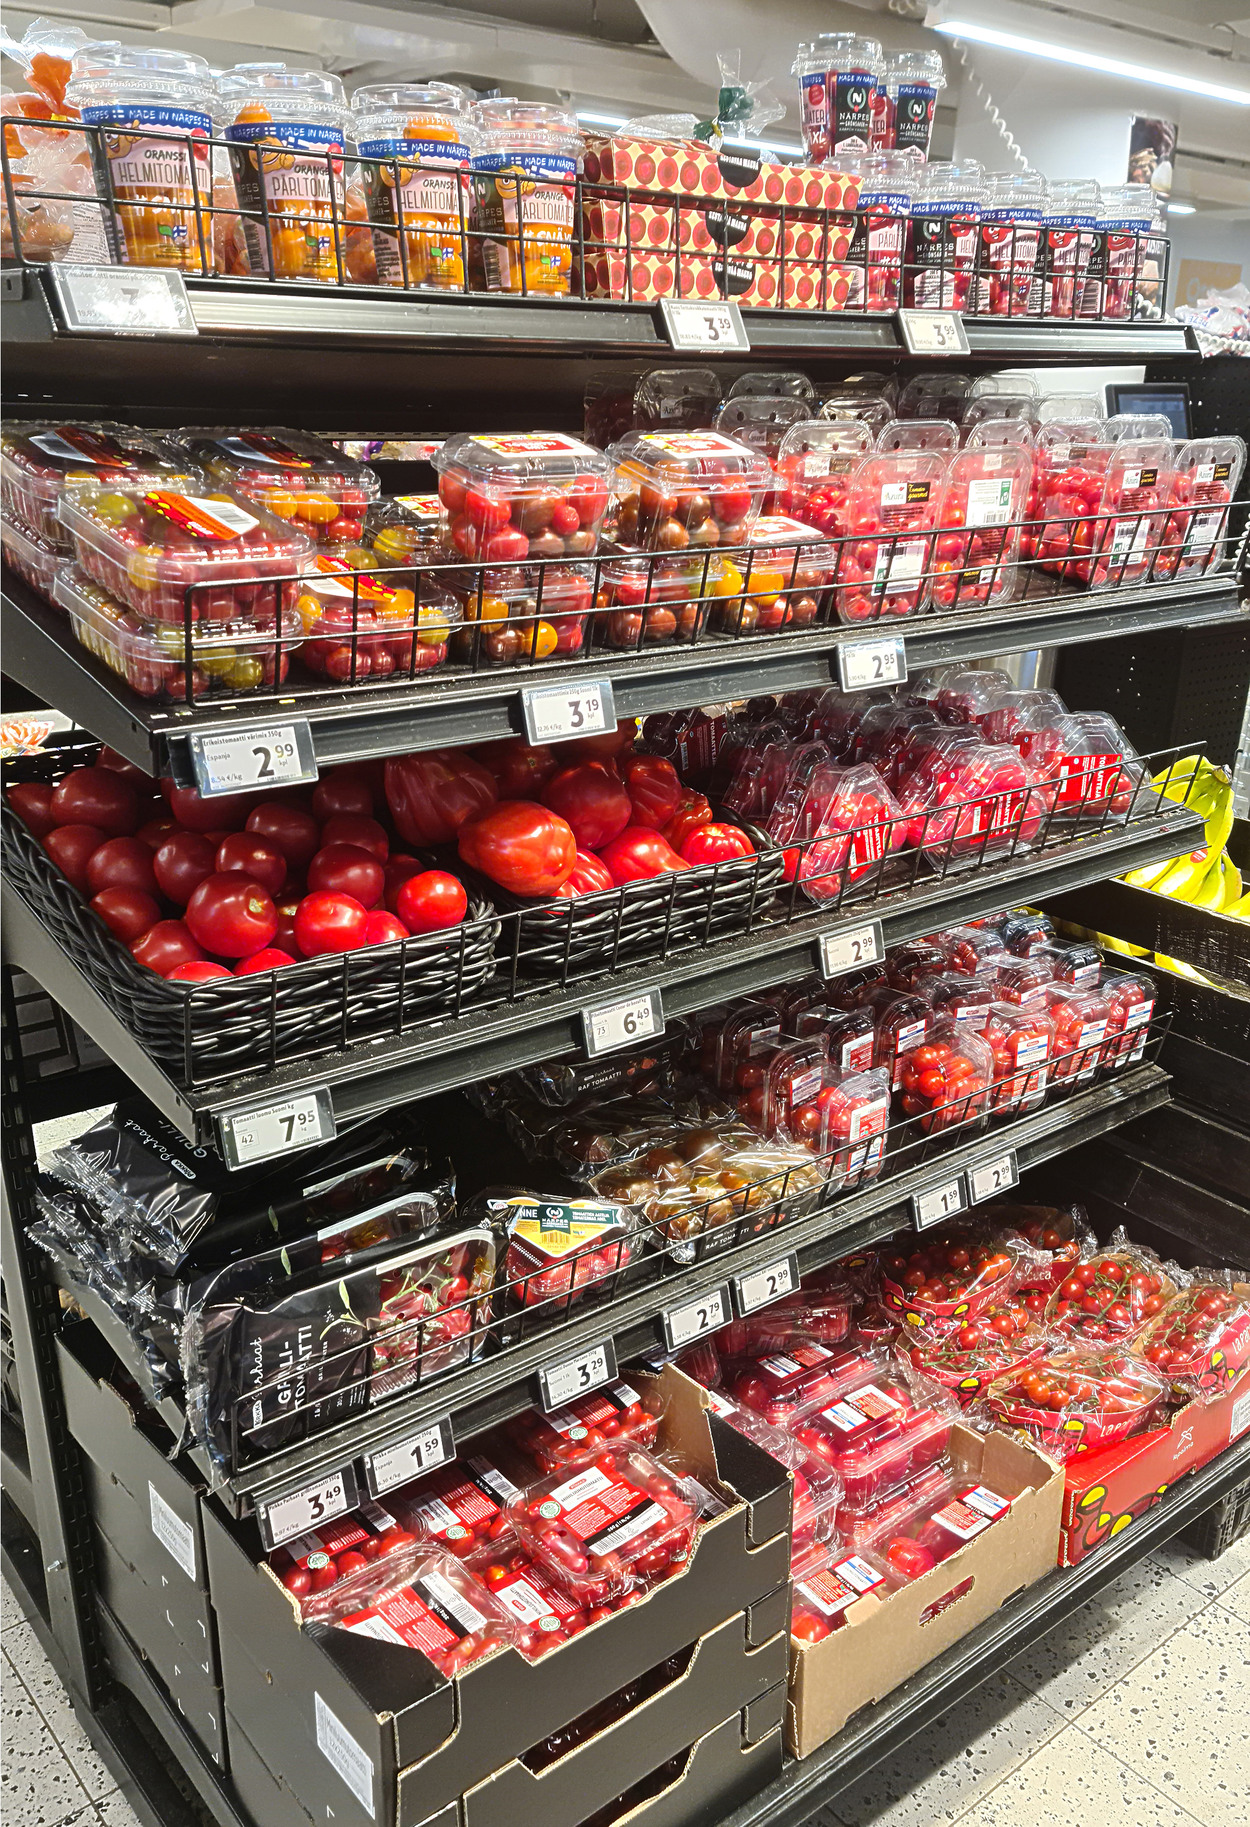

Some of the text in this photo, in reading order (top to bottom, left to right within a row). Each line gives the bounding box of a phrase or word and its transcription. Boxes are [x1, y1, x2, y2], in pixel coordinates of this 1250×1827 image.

[144, 149, 187, 162] ORANSSI
[117, 161, 208, 189] HELMITOMATTI
[271, 174, 344, 200] PÄRLTOMAER
[534, 190, 565, 202] ORANGE
[703, 316, 731, 341] 3 39
[932, 324, 955, 346] 3 99
[871, 653, 895, 679] 2 95
[567, 698, 599, 728] 3 19
[202, 734, 247, 747] Erikoistomaatti
[267, 729, 283, 738] 350g
[206, 742, 295, 779] Espanja 2 99
[850, 940, 863, 963] 2
[862, 936, 873, 948] 99
[596, 1007, 650, 1036] 73 6 49
[577, 1070, 622, 1092] RAF TOMAATTI
[232, 1102, 295, 1126] Tomaatti luomu Suomi kg
[241, 1109, 316, 1145] 42 7 95
[123, 1118, 175, 1161] Parhaat
[992, 1165, 1010, 1189] 2 99
[519, 1208, 538, 1219] NNE
[940, 1193, 949, 1212] 1
[948, 1189, 958, 1201] 59
[705, 1226, 750, 1250] RAF TOMATTI
[766, 1269, 789, 1297] 2 99
[696, 1308, 709, 1331] 2
[708, 1302, 720, 1315] 79
[577, 1356, 604, 1388] 3 29
[410, 1444, 424, 1469] 1
[424, 1437, 439, 1453] 59
[268, 1501, 284, 1511] Pirkka
[307, 1484, 342, 1521] 3 49
